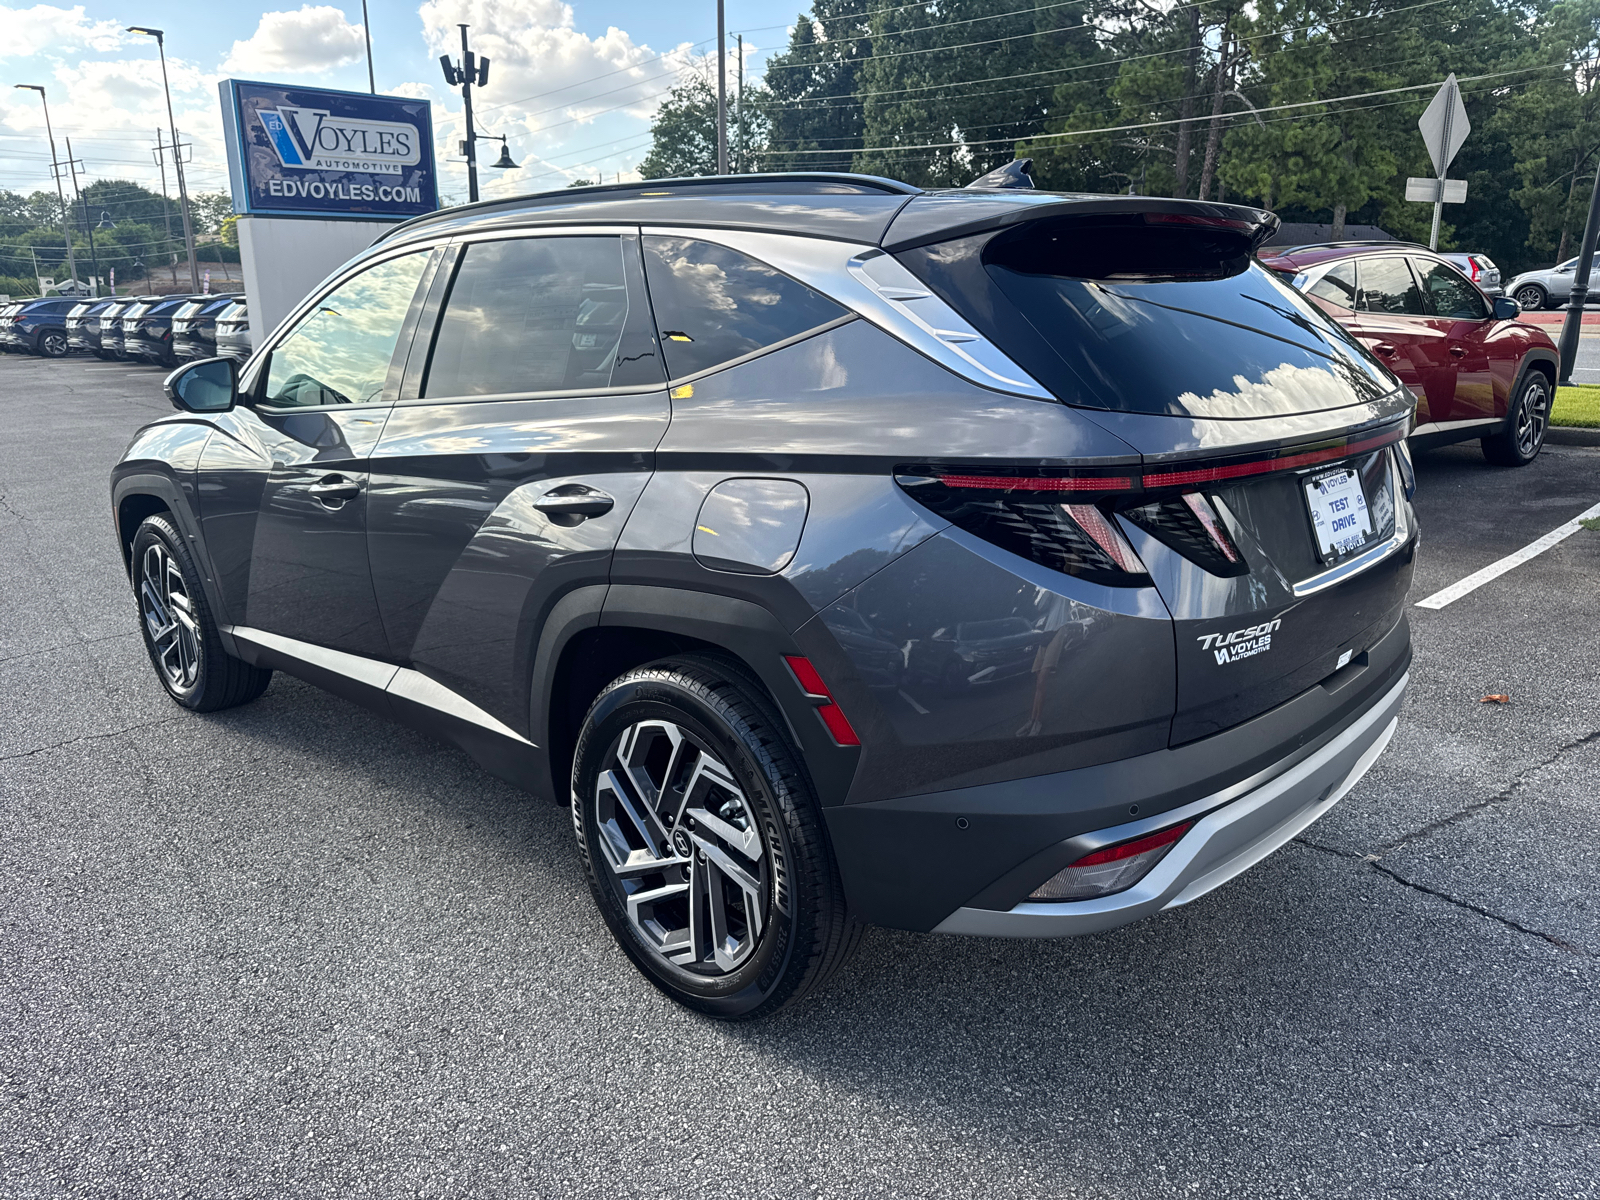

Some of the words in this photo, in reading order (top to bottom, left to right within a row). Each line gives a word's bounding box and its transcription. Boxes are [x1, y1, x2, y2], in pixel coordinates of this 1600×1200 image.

[268, 121, 283, 131] ED
[282, 109, 411, 161] VOYLES
[316, 159, 400, 172] AUTOMOTIVE
[269, 180, 421, 203] EDVOYLES.COM
[1326, 475, 1348, 489] VOYLES
[1329, 497, 1349, 513] TEST
[1332, 513, 1357, 532] DRIVE
[1230, 634, 1272, 655] VOYLES
[1230, 643, 1271, 662] AUTOMOTIVE
[573, 798, 601, 895] MICHELIN
[756, 789, 789, 910] MICHELIN
